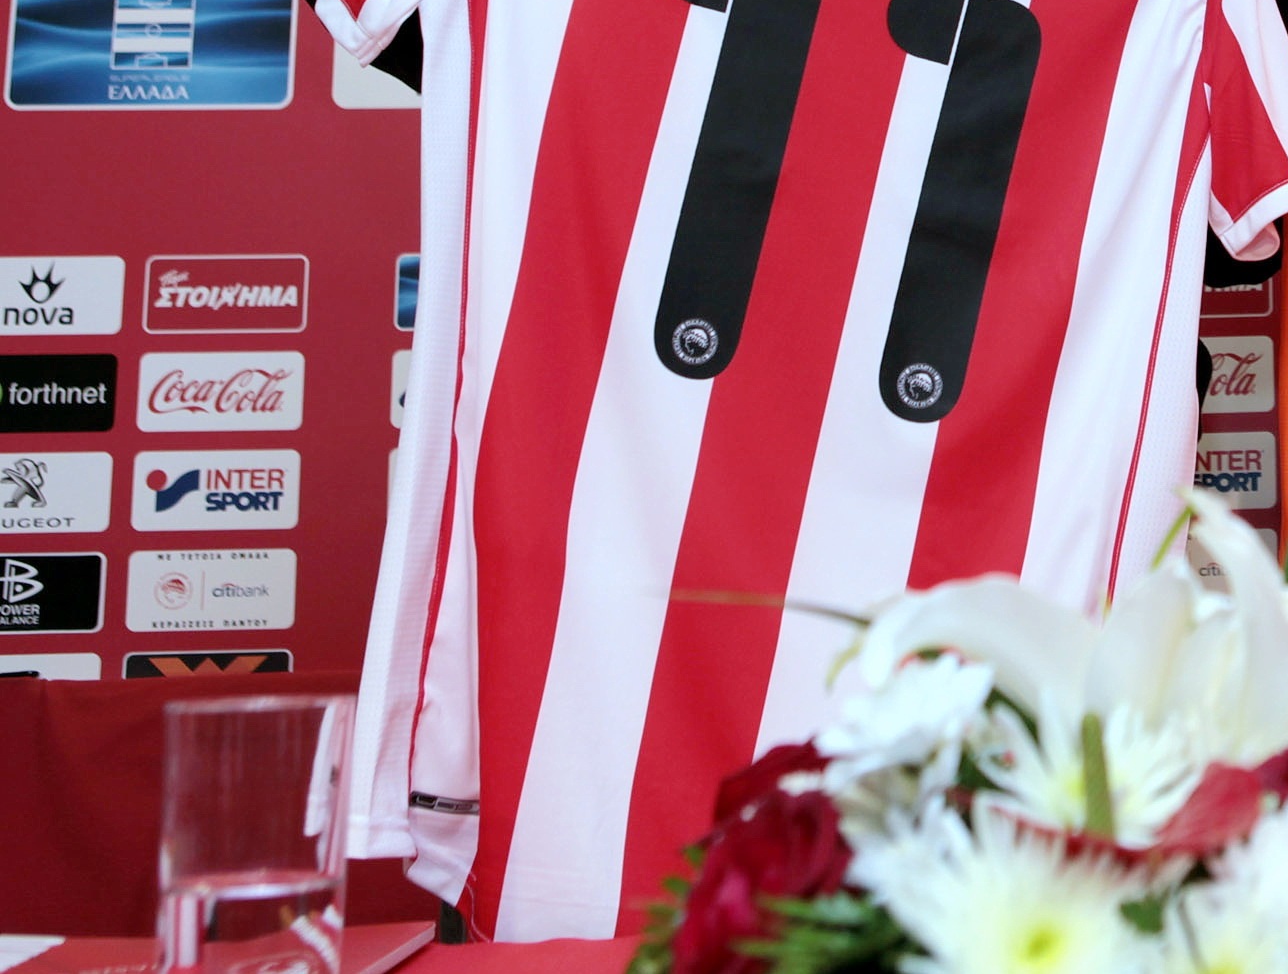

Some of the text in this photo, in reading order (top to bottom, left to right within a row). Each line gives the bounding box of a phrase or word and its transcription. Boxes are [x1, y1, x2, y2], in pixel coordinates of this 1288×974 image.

[154, 283, 298, 310] ΣΤΟΙΧΗΜΑ
[4, 307, 74, 325] nova
[9, 382, 107, 404] forthnet
[148, 369, 292, 414] Coca-Cola
[206, 469, 285, 490] INTER
[206, 492, 284, 511] SPORT
[212, 583, 269, 598] citibank
